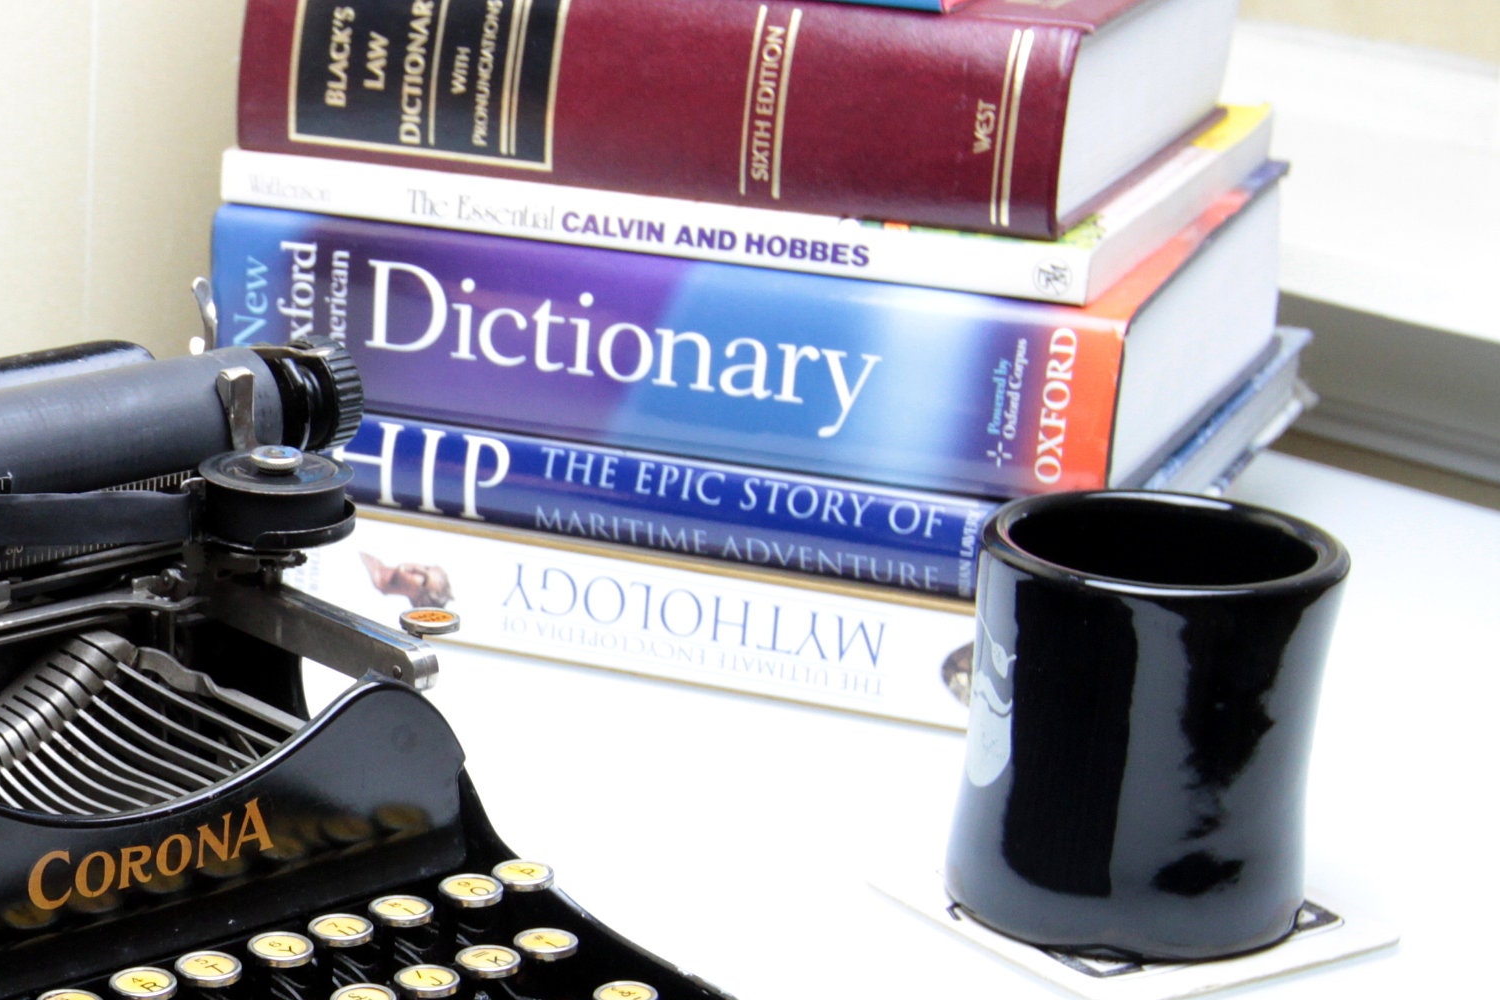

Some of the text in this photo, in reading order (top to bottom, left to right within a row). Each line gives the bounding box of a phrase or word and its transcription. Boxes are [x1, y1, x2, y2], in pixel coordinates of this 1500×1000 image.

[324, 5, 356, 108] BLACK'S
[363, 30, 390, 91] LAW
[399, 0, 436, 145] DICTIONAR
[450, 46, 472, 95] WITH
[750, 24, 786, 182] SIXTH EDITION
[973, 99, 998, 155] WEST
[406, 187, 870, 269] The Essential CALVIN AND HOBBES
[233, 255, 269, 347] New
[276, 240, 318, 341] xford
[325, 249, 350, 348] erican
[364, 258, 883, 439] Dictionary
[986, 356, 1012, 436] Powered by
[1002, 337, 1029, 441] Oxford Corpus
[1034, 327, 1078, 485] OXFORD
[331, 421, 946, 539] HIP THE EPIC STORY OF
[535, 505, 940, 591] MARITIME ADVENTURE
[501, 562, 886, 669] MYTHOLOGY
[536, 620, 708, 666] ENCYCLOPEDIA
[717, 652, 830, 688] ULTIMATE
[842, 672, 884, 697] THE
[27, 798, 276, 912] CORONA
